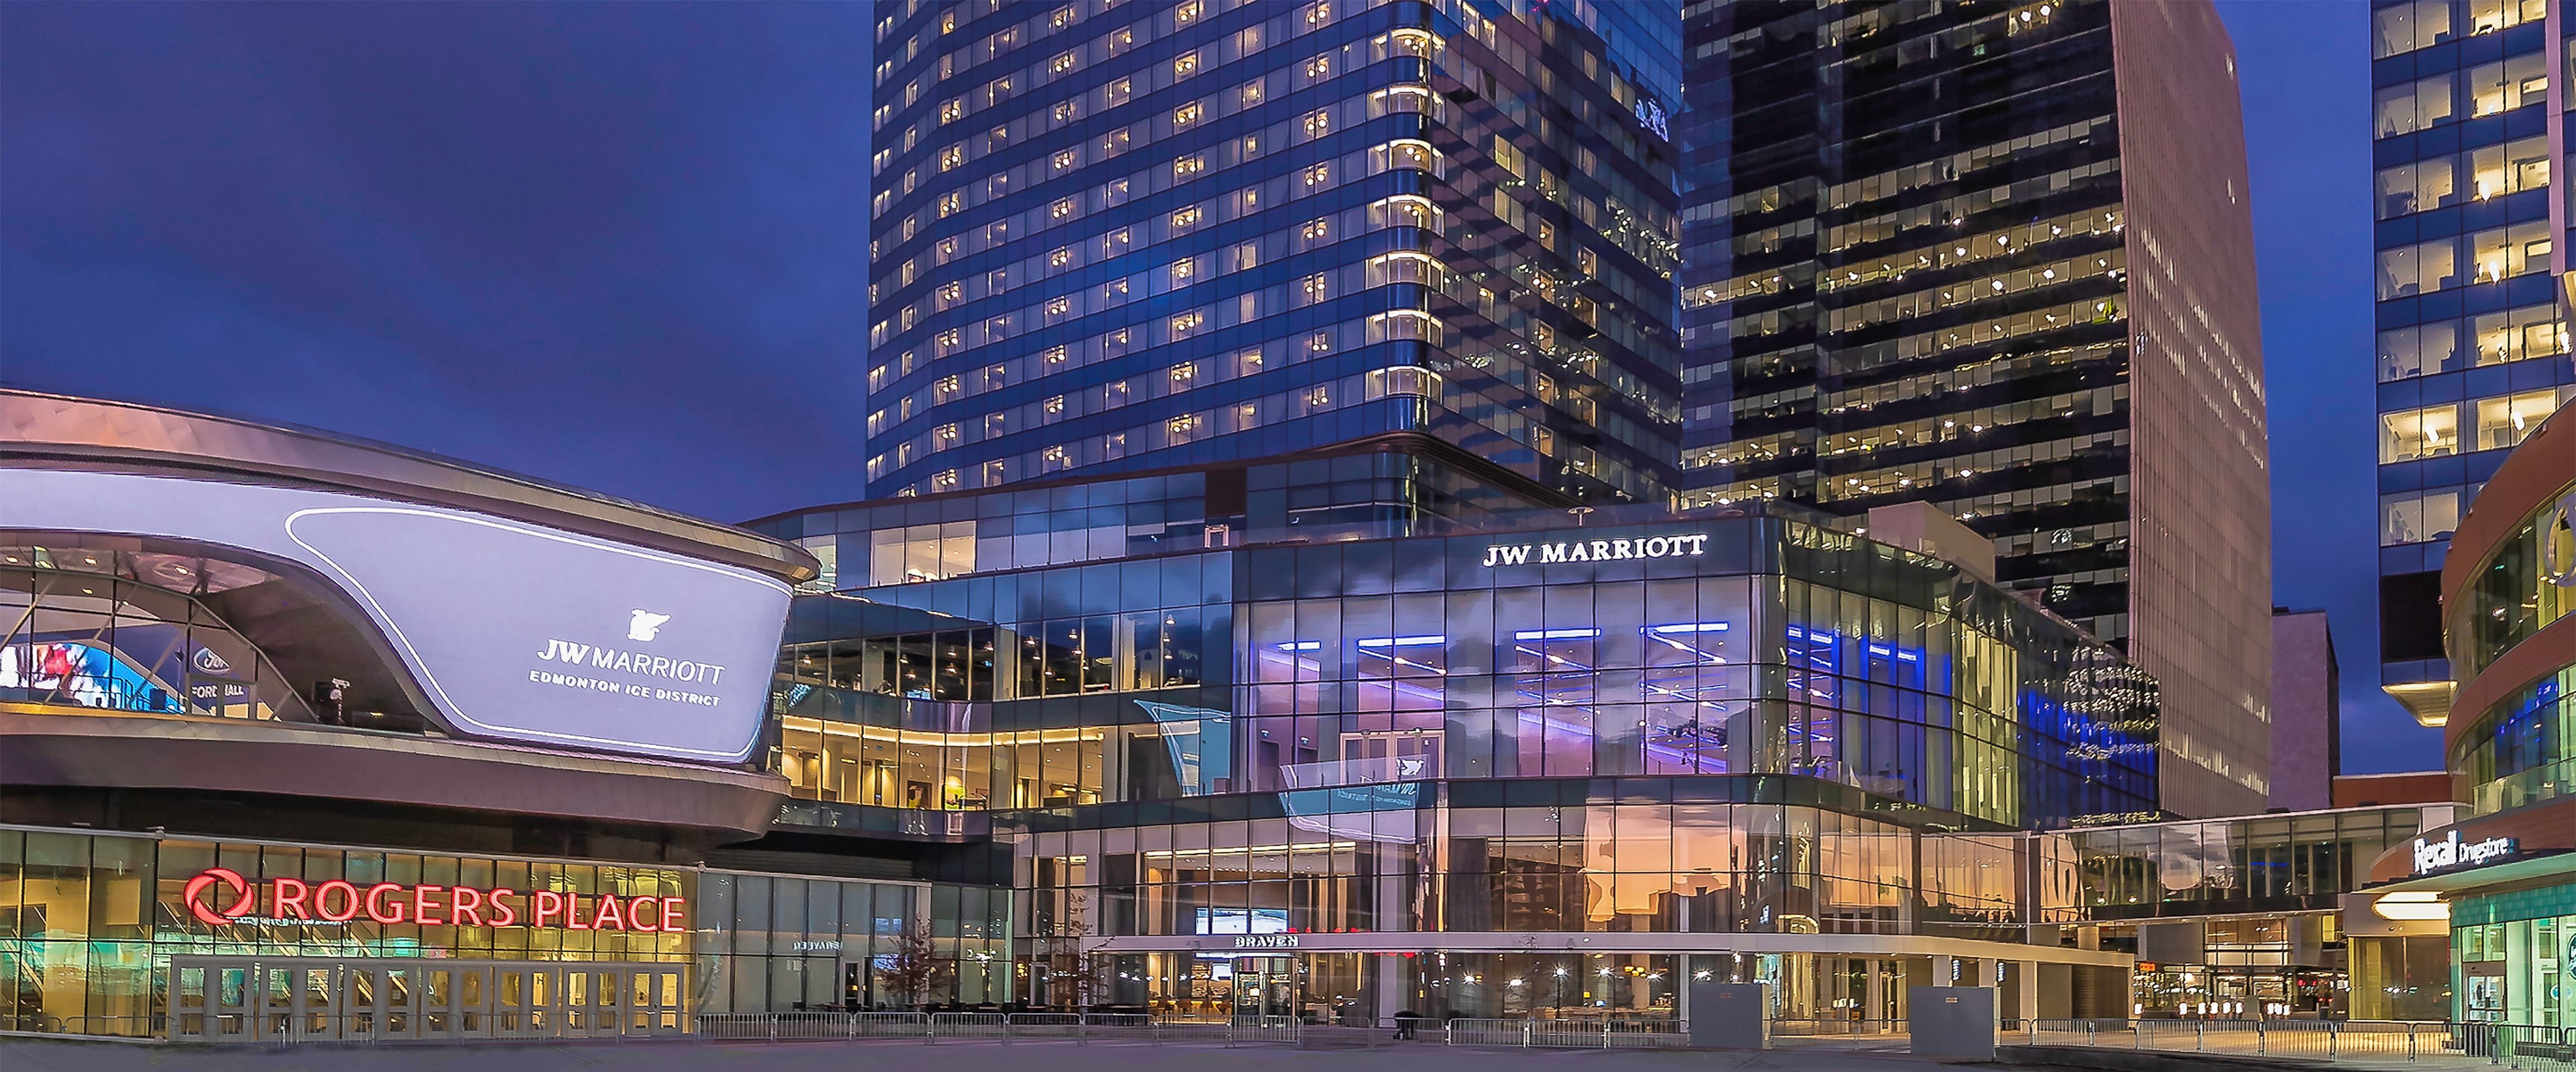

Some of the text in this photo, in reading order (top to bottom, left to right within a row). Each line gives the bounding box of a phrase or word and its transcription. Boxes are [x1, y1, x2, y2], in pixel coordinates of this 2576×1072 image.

[1483, 535, 1707, 567] JW MARRIOTT
[537, 639, 725, 685] JW MARRIOTT
[529, 670, 720, 707] EDMONTON ICE DISTRICT
[2414, 830, 2508, 875] Rexall Drugstore
[273, 877, 686, 932] ROGERS PLACE
